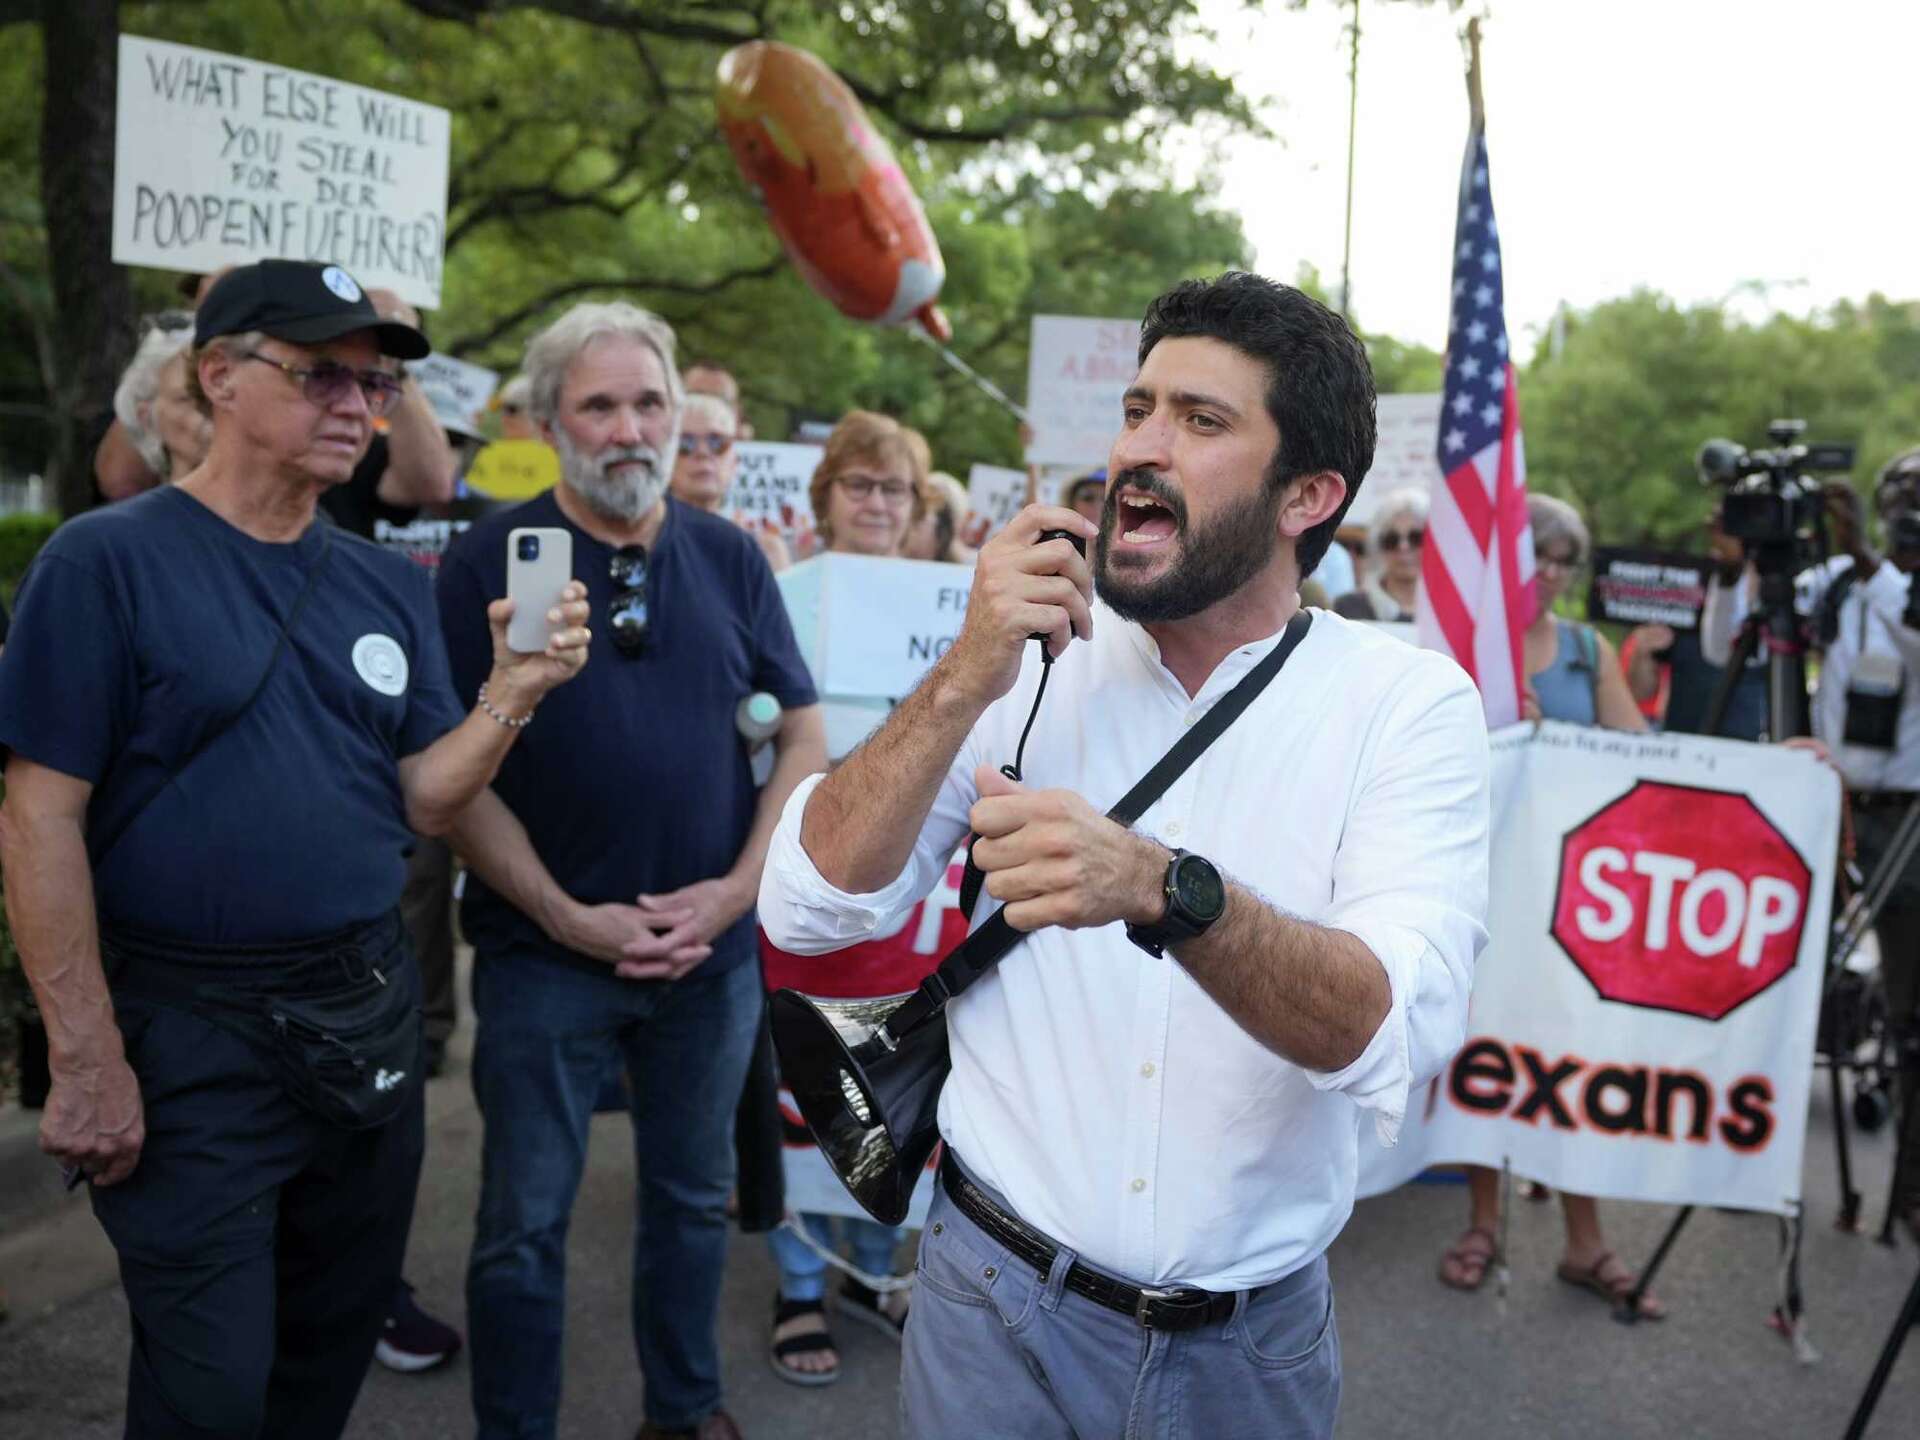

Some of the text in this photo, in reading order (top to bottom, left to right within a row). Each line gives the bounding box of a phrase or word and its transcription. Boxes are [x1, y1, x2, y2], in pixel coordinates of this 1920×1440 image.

[145, 53, 430, 147] WHAT ELSE WILL
[220, 116, 398, 185] YOU STEAL
[230, 162, 378, 210] FOR DER
[1574, 847, 1799, 969] STOP
